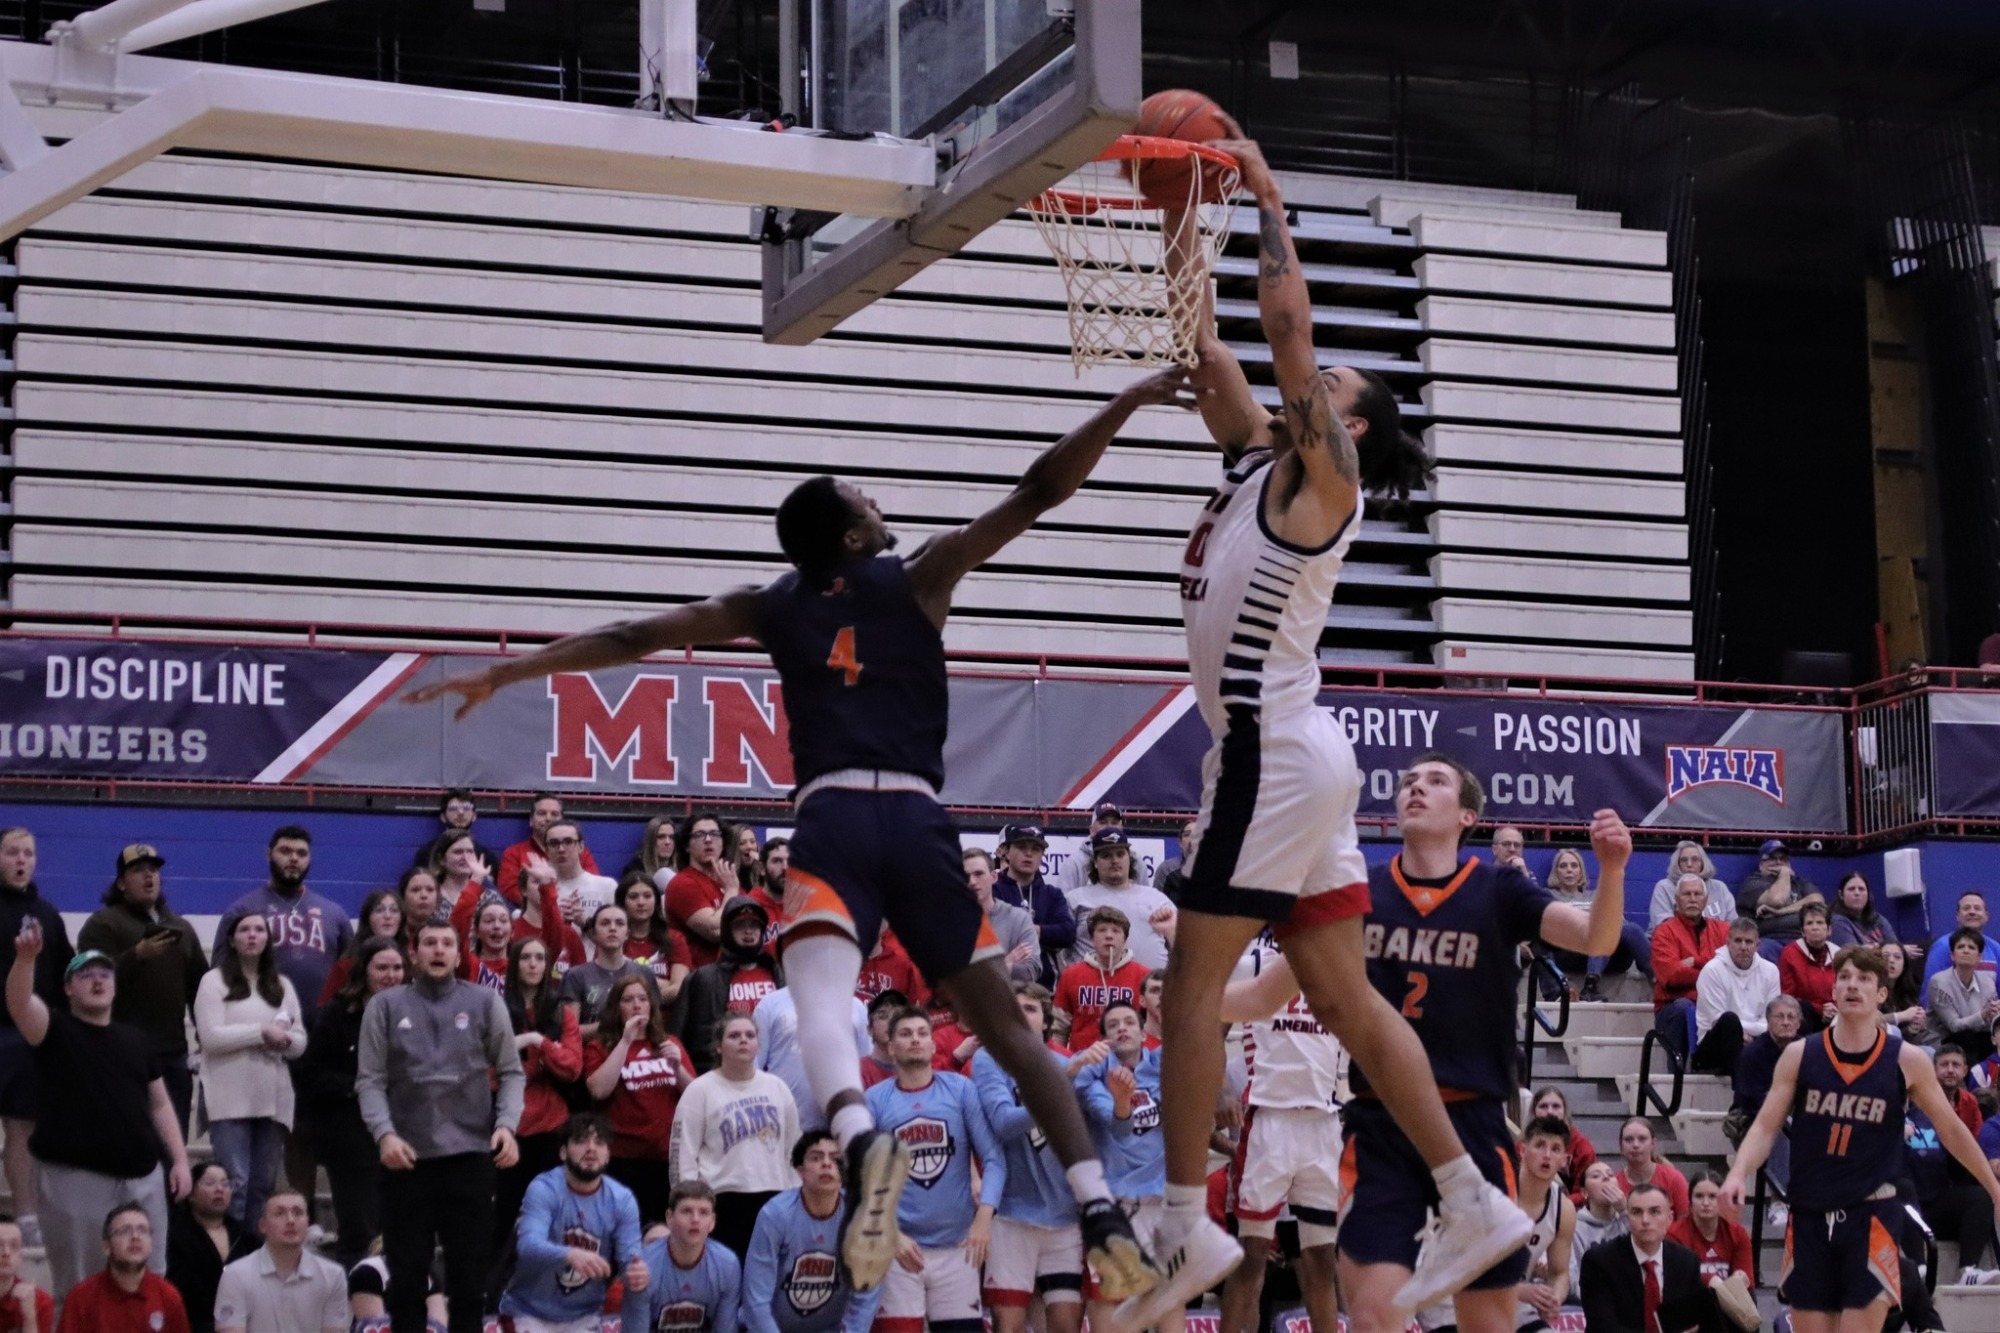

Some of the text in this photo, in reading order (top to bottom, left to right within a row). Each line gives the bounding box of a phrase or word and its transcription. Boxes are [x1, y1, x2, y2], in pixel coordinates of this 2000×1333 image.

[826, 626, 864, 686] 4
[45, 654, 286, 706] DISCIPLINE
[1493, 712, 1641, 757] PASSION
[1666, 745, 1784, 803] NAIA
[266, 914, 326, 953] USA
[1364, 923, 1479, 969] BAKER
[1401, 970, 1429, 1019] 2
[719, 1103, 781, 1155] RAMS
[1804, 1088, 1888, 1124] BAKER
[897, 1123, 944, 1146] MNU
[1826, 1122, 1853, 1157] 11
